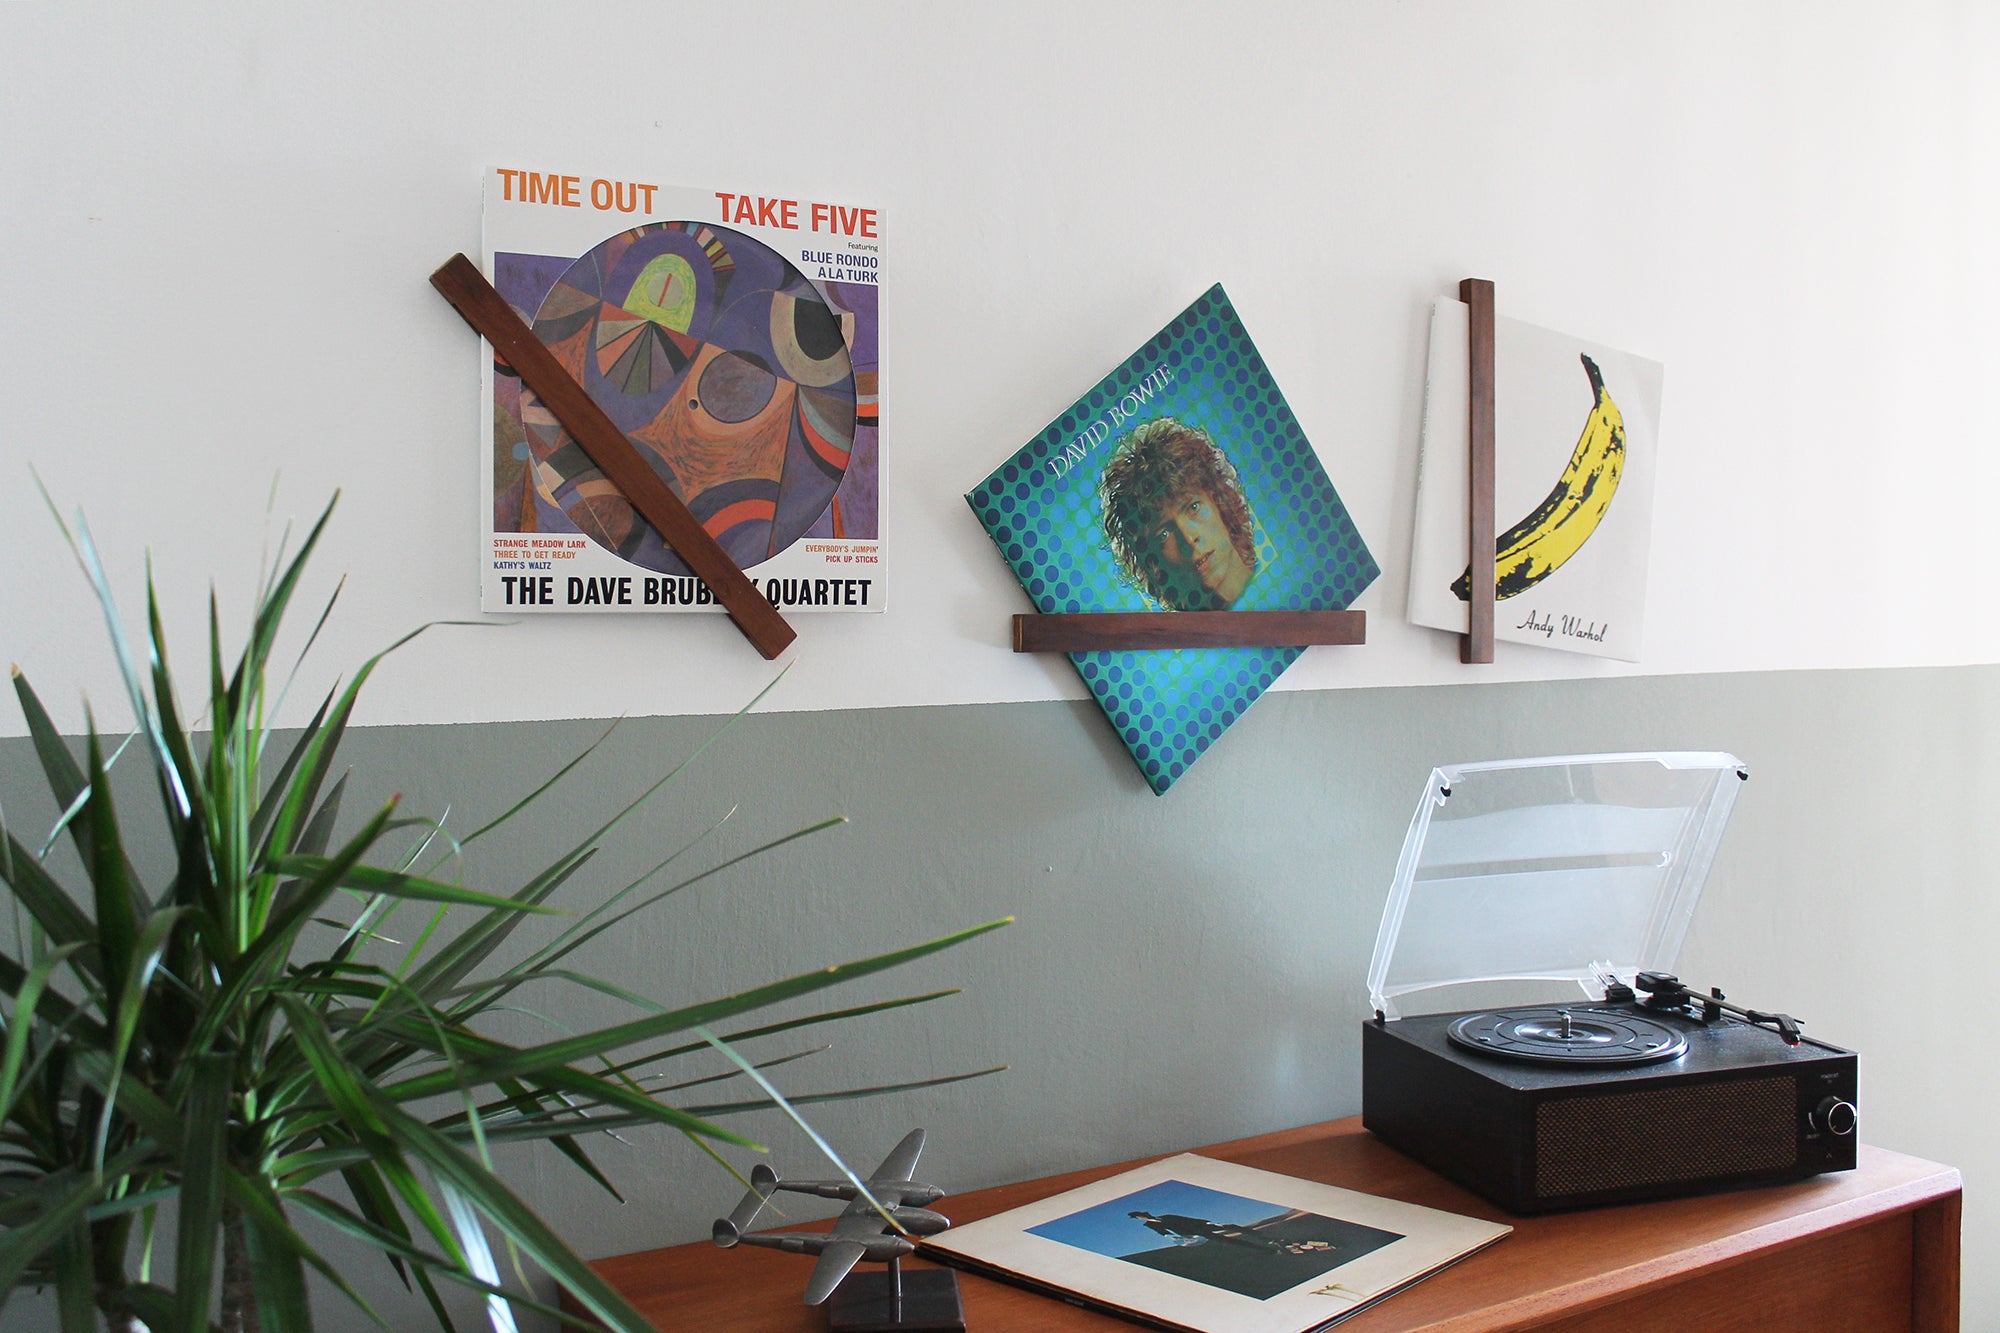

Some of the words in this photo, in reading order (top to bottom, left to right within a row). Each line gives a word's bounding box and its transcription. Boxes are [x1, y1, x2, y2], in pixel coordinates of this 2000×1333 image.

[497, 169, 581, 207] TIME
[590, 178, 658, 215] OUT
[715, 192, 798, 230] TAKE
[811, 204, 878, 238] FIVE
[848, 242, 879, 252] Featuring
[802, 250, 832, 264] BLUE
[836, 253, 878, 268] RONDO
[818, 267, 826, 278] A
[829, 268, 844, 279] LA
[846, 269, 878, 283] TURK
[1048, 420, 1109, 480] DAVID
[1107, 363, 1175, 428] BOWIE
[493, 539, 528, 548] STRANGE
[532, 540, 564, 548] MEADOW
[805, 544, 849, 553] EVERYBODY'S
[493, 550, 518, 559] THREE
[522, 551, 531, 559] TO
[535, 551, 548, 559] GET
[552, 551, 576, 559] READY
[493, 561, 525, 570] KATHY'S
[528, 561, 551, 570] WALTZ
[501, 576, 553, 605] THE
[568, 577, 632, 605] DAVE
[644, 577, 759, 605] BRUB
[766, 578, 873, 611] QUARTET
[1516, 609, 1554, 638] Andy
[1561, 614, 1608, 642] Warhol
